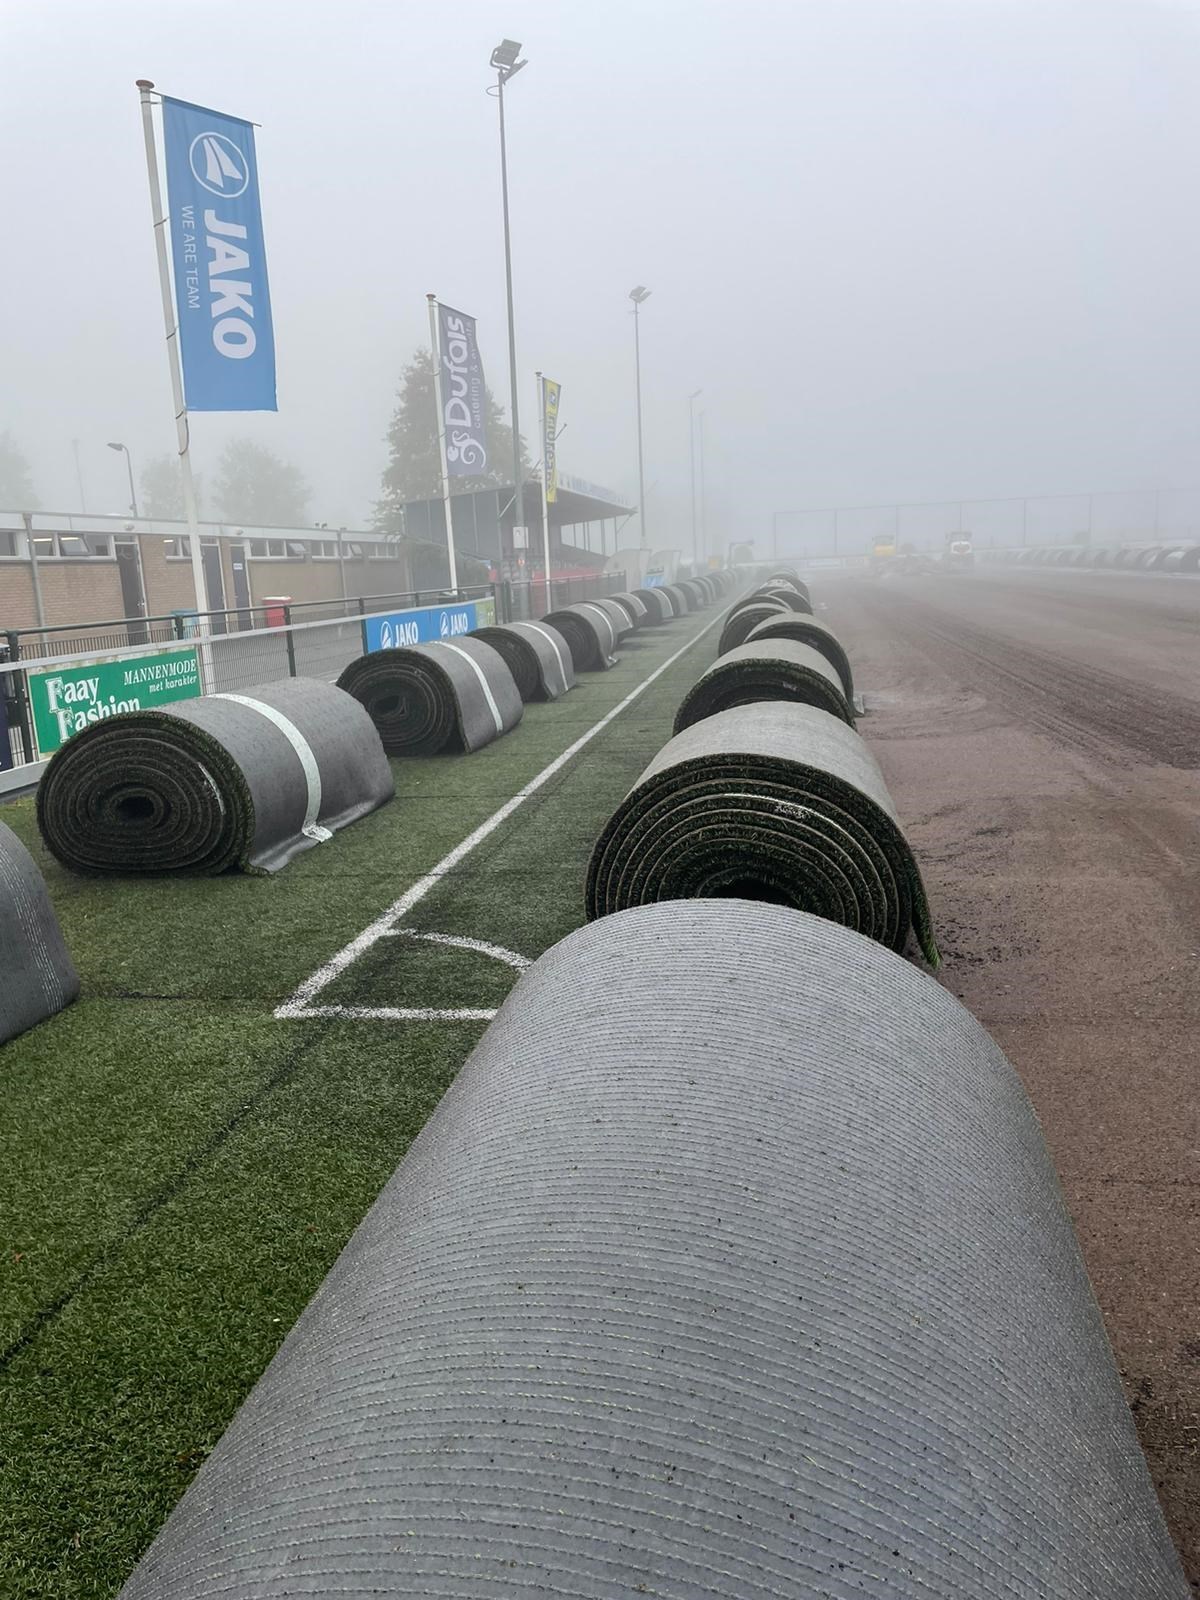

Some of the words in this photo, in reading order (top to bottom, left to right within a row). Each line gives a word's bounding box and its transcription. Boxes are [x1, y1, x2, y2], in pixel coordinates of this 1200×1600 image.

[181, 205, 195, 229] WE
[183, 233, 197, 265] ARE
[186, 267, 200, 308] TEAM
[204, 209, 257, 359] JAKO
[470, 378, 481, 429] catering
[395, 621, 419, 647] JAKO
[450, 612, 468, 636] JAKO
[124, 659, 197, 686] MANNENMODE
[149, 682, 163, 693] met
[165, 674, 197, 690] karakter
[45, 676, 100, 714] Faay
[56, 695, 140, 744] Fashion
